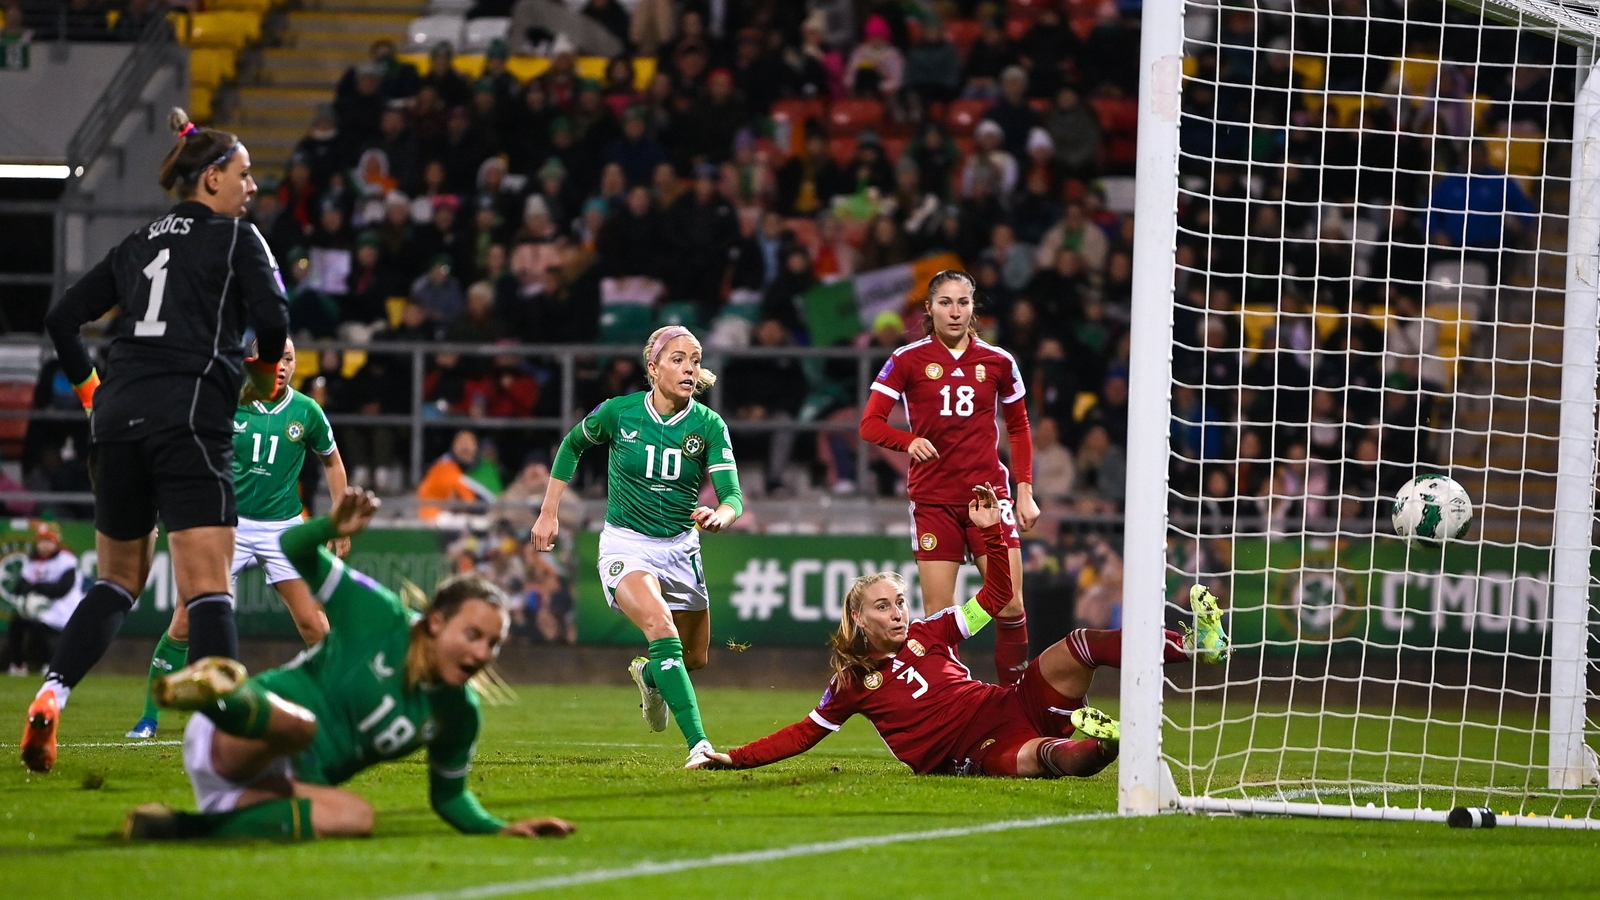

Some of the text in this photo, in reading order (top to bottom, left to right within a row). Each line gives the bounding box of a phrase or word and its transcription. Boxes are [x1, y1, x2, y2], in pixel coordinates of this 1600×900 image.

[134, 248, 170, 336] 1
[939, 385, 975, 417] 18
[252, 433, 279, 465] 11
[645, 445, 682, 481] 10
[999, 499, 1017, 525] 8
[1382, 571, 1550, 633] C'MON
[897, 666, 929, 699] 3
[358, 694, 416, 753] 18
